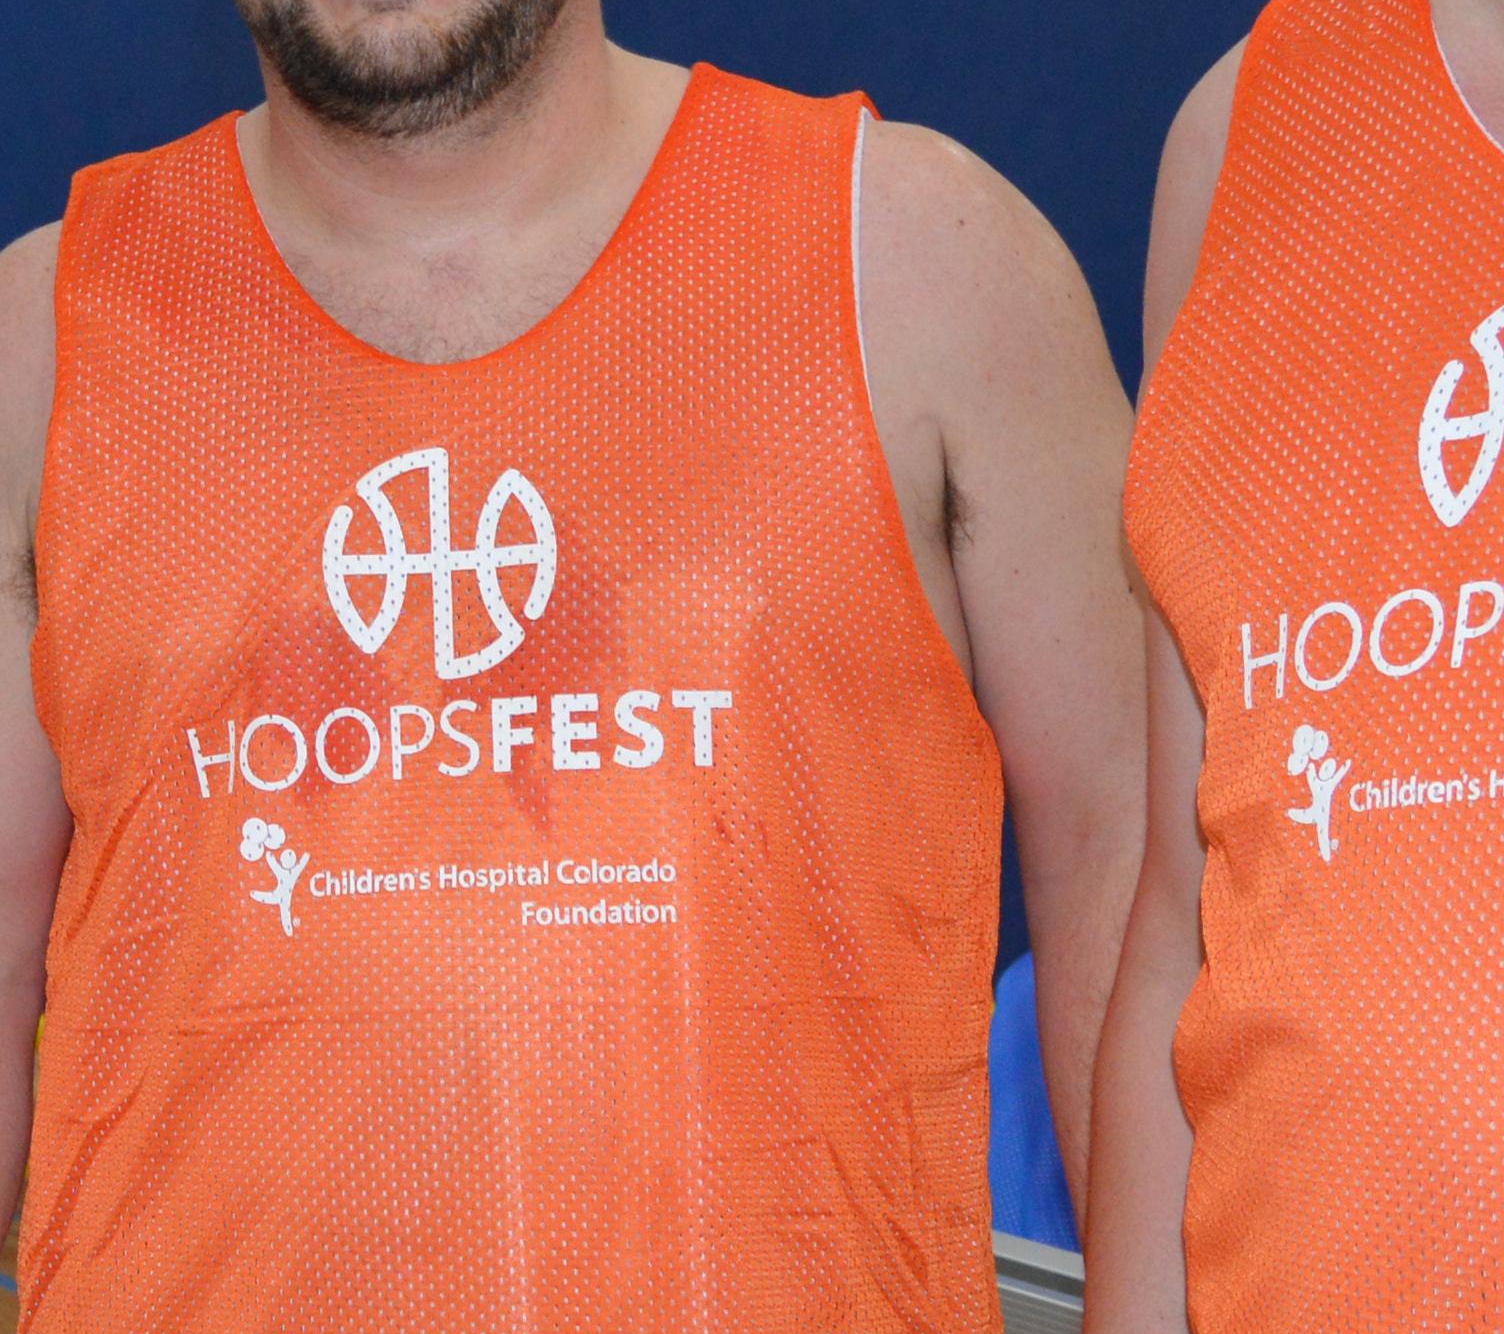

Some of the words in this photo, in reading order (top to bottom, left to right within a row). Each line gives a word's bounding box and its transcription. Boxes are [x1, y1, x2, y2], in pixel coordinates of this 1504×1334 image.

[187, 690, 733, 798] HOOPSFEST
[1348, 778, 1481, 813] Children's
[309, 867, 431, 898] Children's
[438, 861, 550, 893] Hospital
[556, 859, 676, 886] Colorado
[521, 900, 677, 927] Foundation
